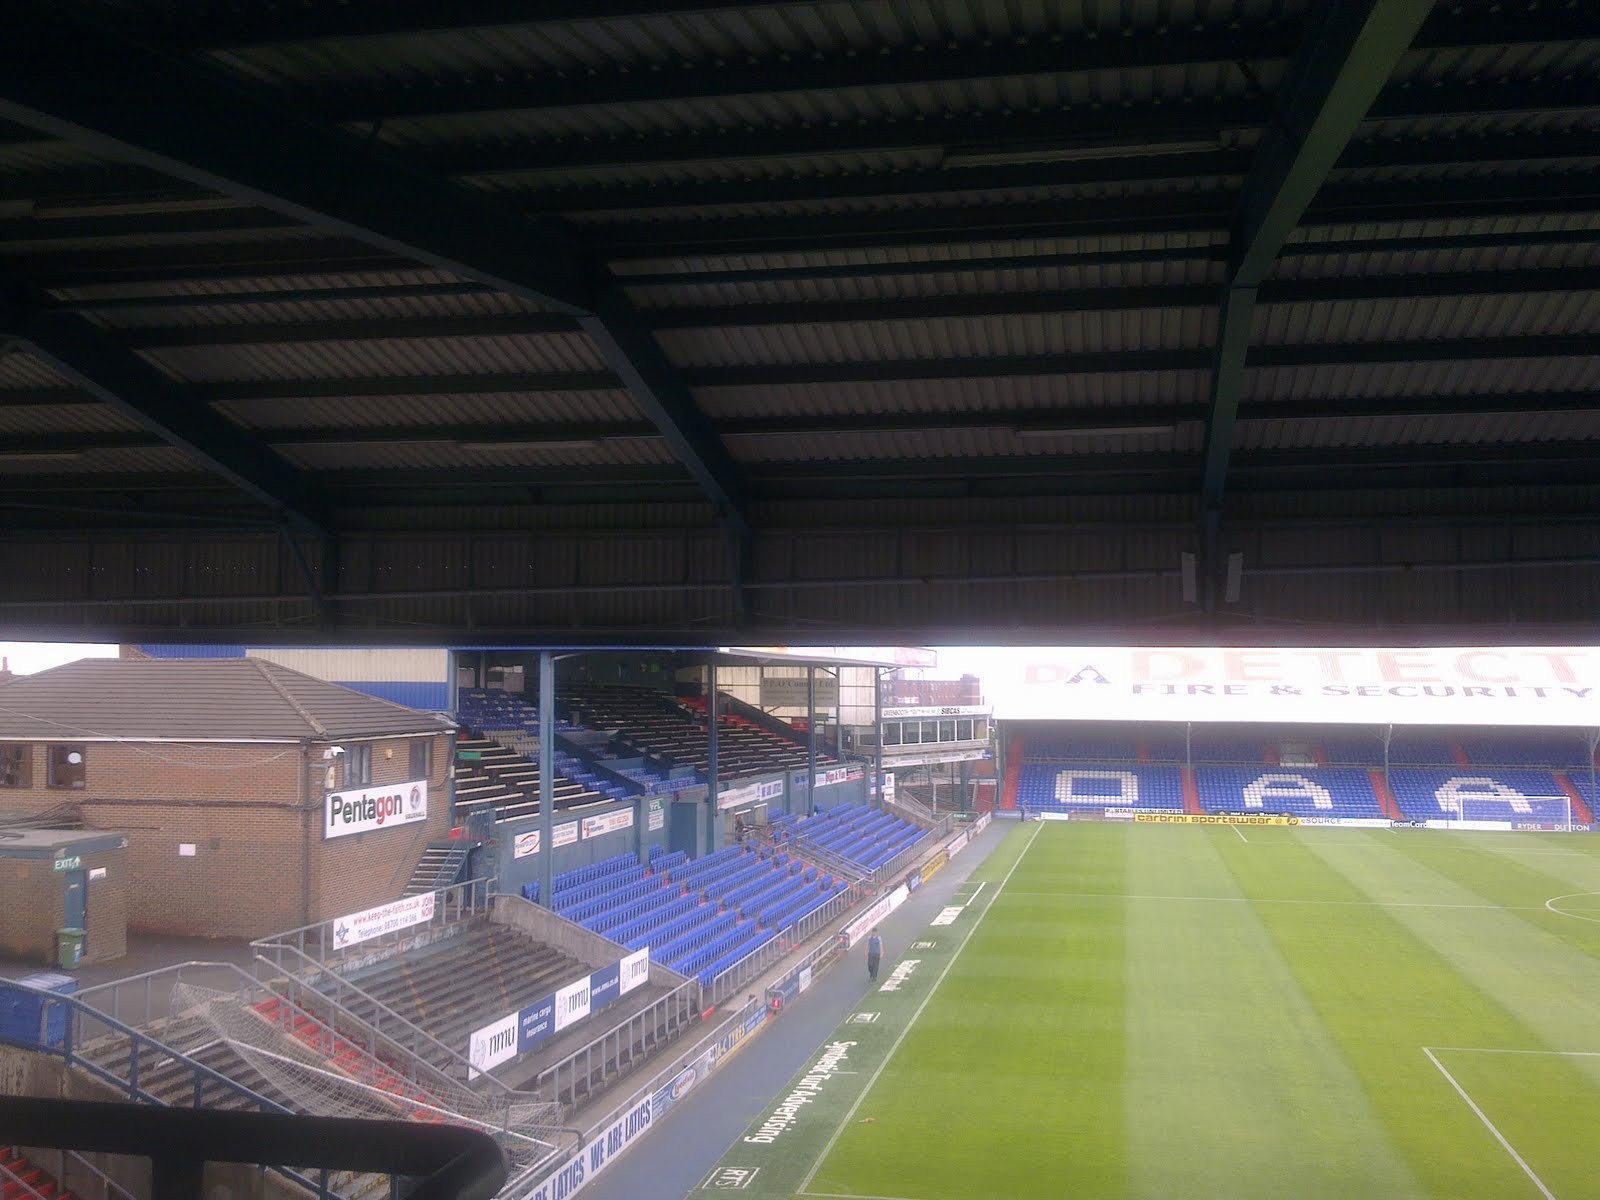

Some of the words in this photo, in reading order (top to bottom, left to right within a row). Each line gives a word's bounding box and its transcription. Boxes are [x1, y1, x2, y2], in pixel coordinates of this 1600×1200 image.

[1131, 651, 1588, 682] DETECT
[1132, 684, 1249, 695] FIRE
[1268, 684, 1301, 695] &
[1322, 685, 1592, 698] SECURITY
[331, 794, 402, 826] Pentagon
[1137, 814, 1187, 822] carbrini
[1191, 816, 1271, 824] sportswear
[55, 858, 72, 870] EXIT
[631, 956, 647, 979] nmu
[568, 987, 589, 1013] nmu
[523, 1011, 539, 1027] marine
[539, 1005, 551, 1019] cargo
[489, 1025, 515, 1056] nmu
[526, 1021, 547, 1039] insurance
[744, 1090, 816, 1144] Advertising
[590, 1137, 605, 1172] WE
[607, 1126, 623, 1159] ARE
[625, 1100, 651, 1143] LATICS
[552, 1155, 584, 1200] LATICS
[715, 1168, 749, 1187] RTS
